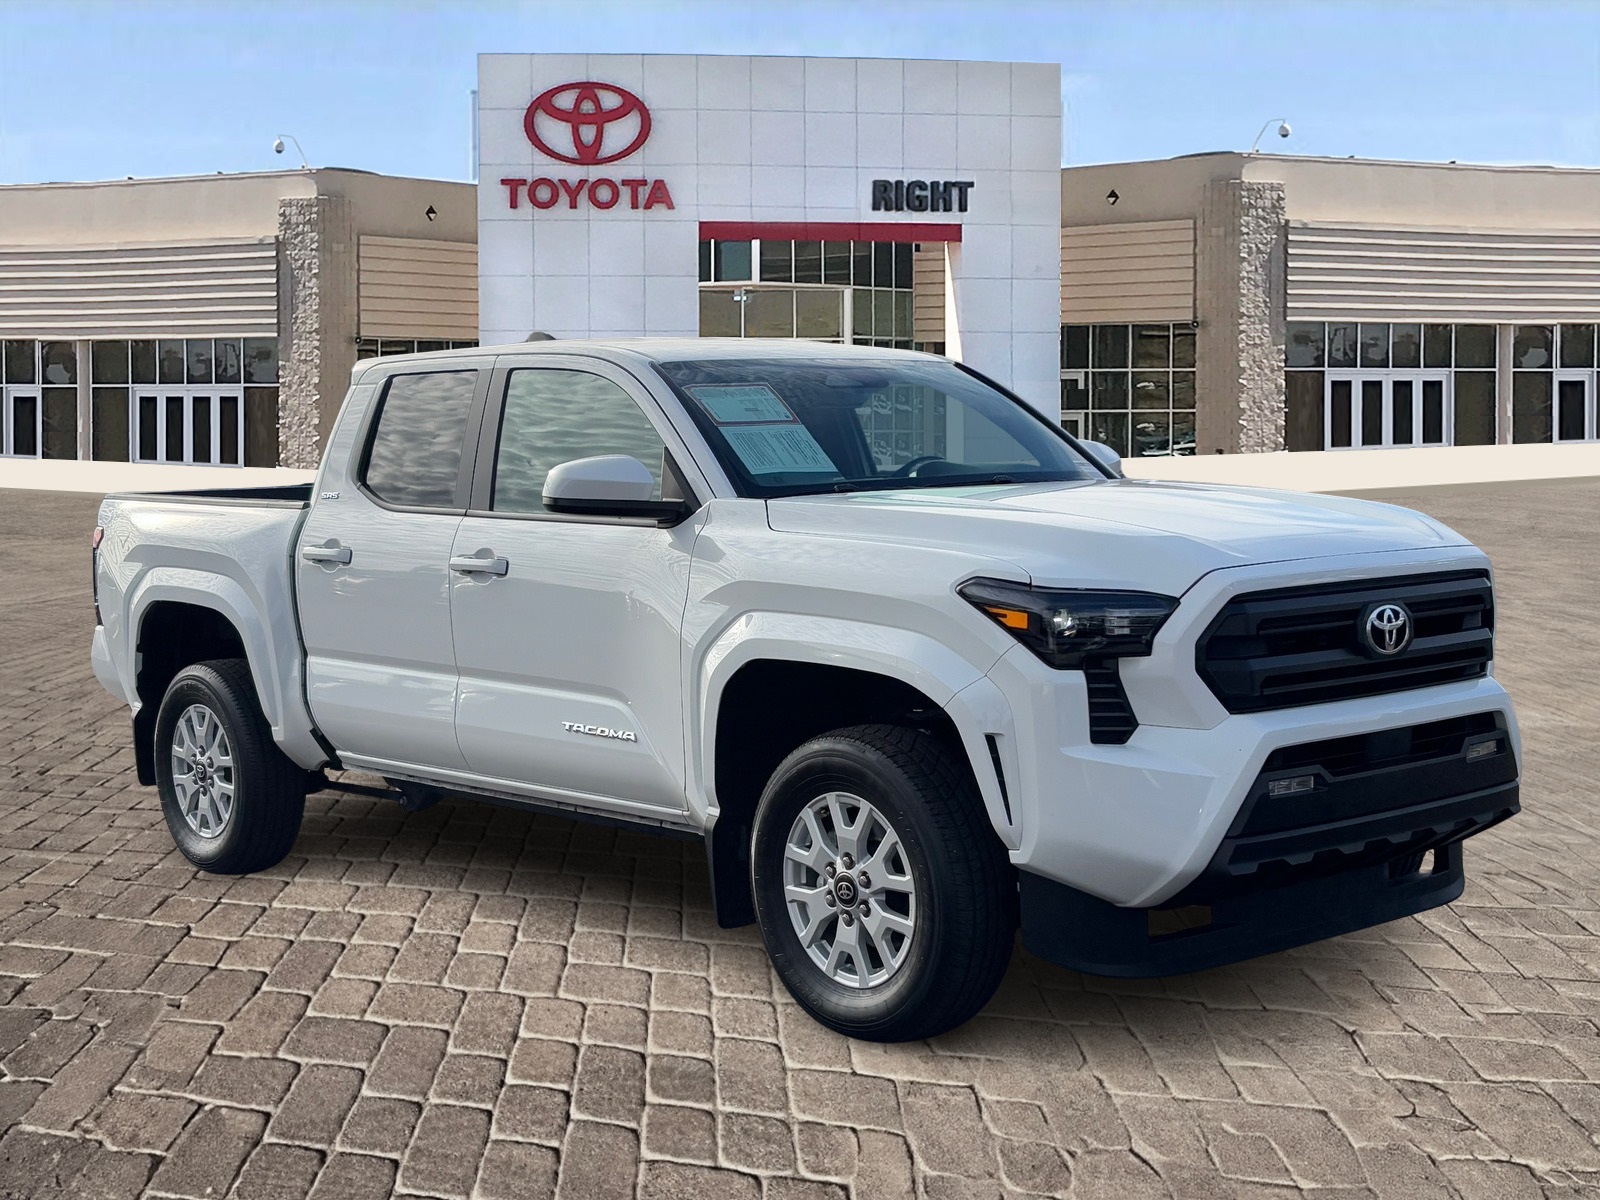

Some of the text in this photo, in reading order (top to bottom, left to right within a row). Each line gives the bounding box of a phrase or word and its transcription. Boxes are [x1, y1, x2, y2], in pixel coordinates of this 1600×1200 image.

[500, 178, 675, 210] TOYOTA
[871, 179, 975, 212] RIGHT
[561, 721, 637, 743] TACOMA
